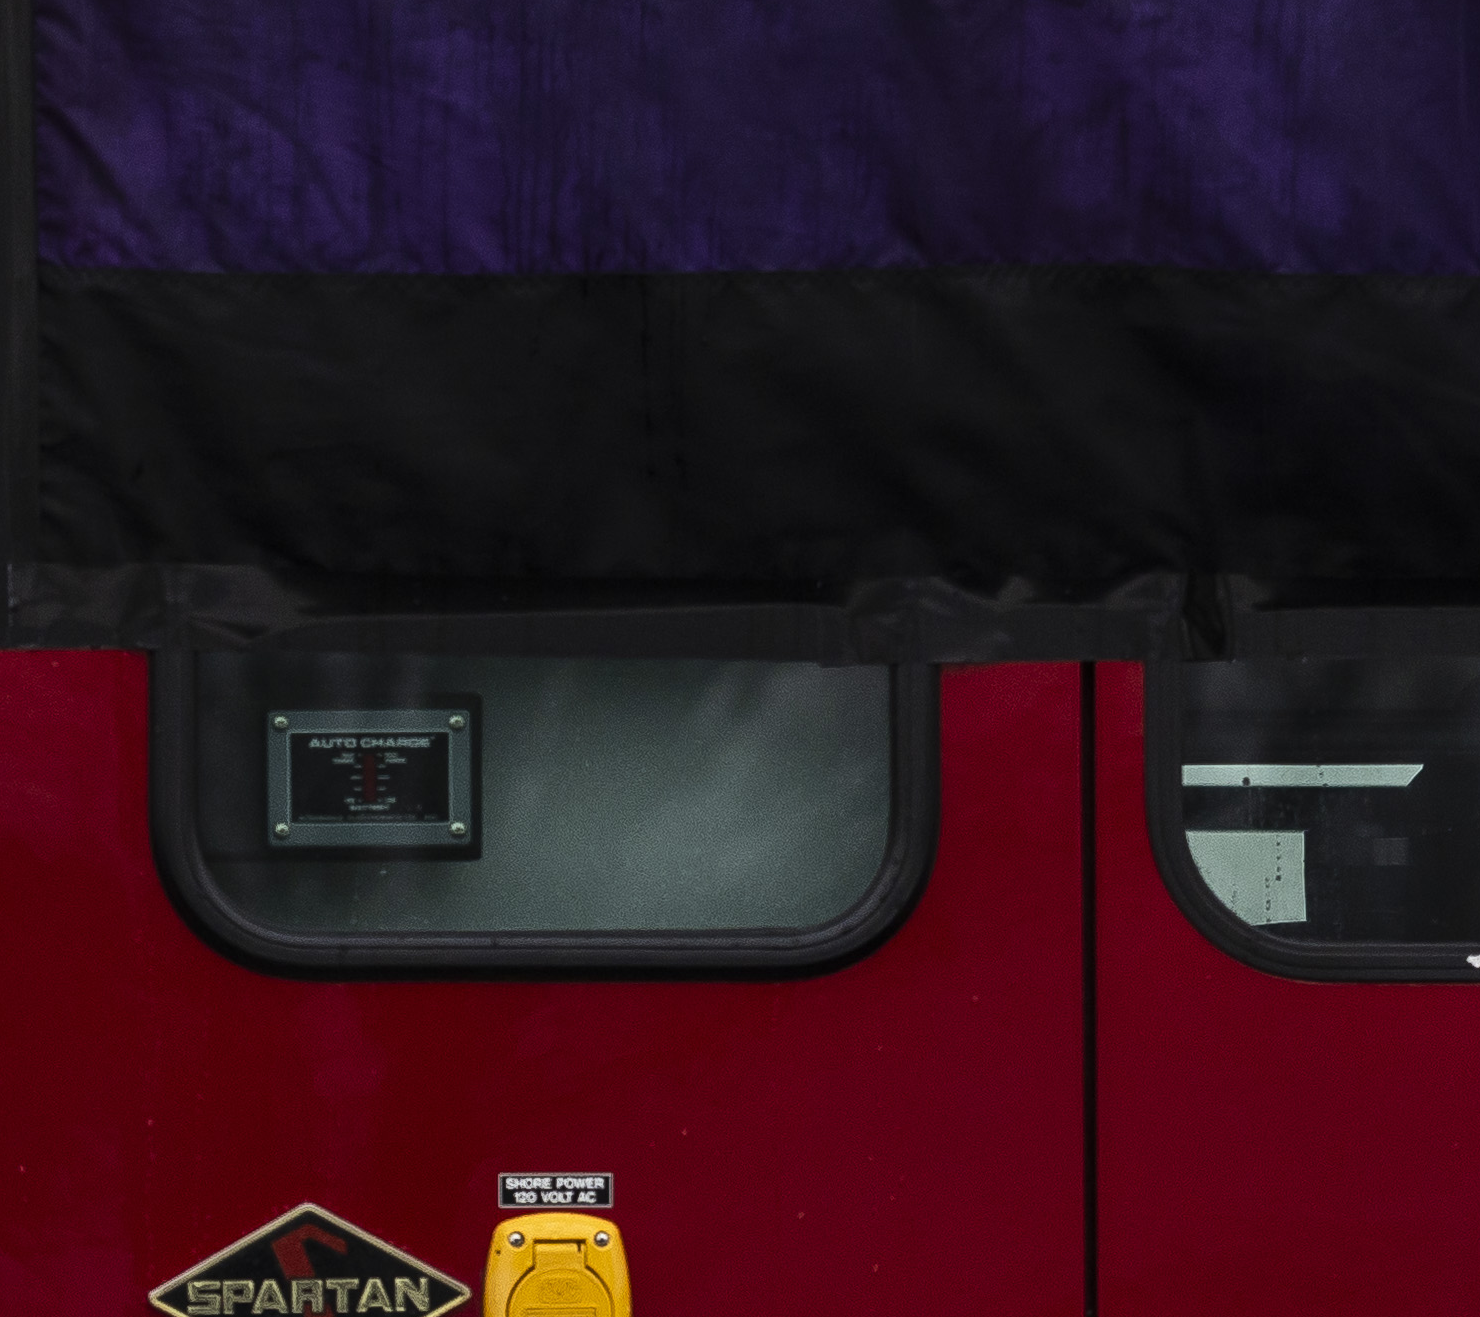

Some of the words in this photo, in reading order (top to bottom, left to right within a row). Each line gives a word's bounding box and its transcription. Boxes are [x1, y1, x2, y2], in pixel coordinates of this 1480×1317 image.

[308, 737, 357, 749] AUTO
[359, 737, 432, 749] CHARGE
[505, 1177, 553, 1190] SHORE
[556, 1177, 605, 1190] POWER
[513, 1191, 538, 1203] 120
[540, 1191, 574, 1203] VOLT
[577, 1191, 597, 1203] AC
[186, 1276, 431, 1316] SPARTAN
